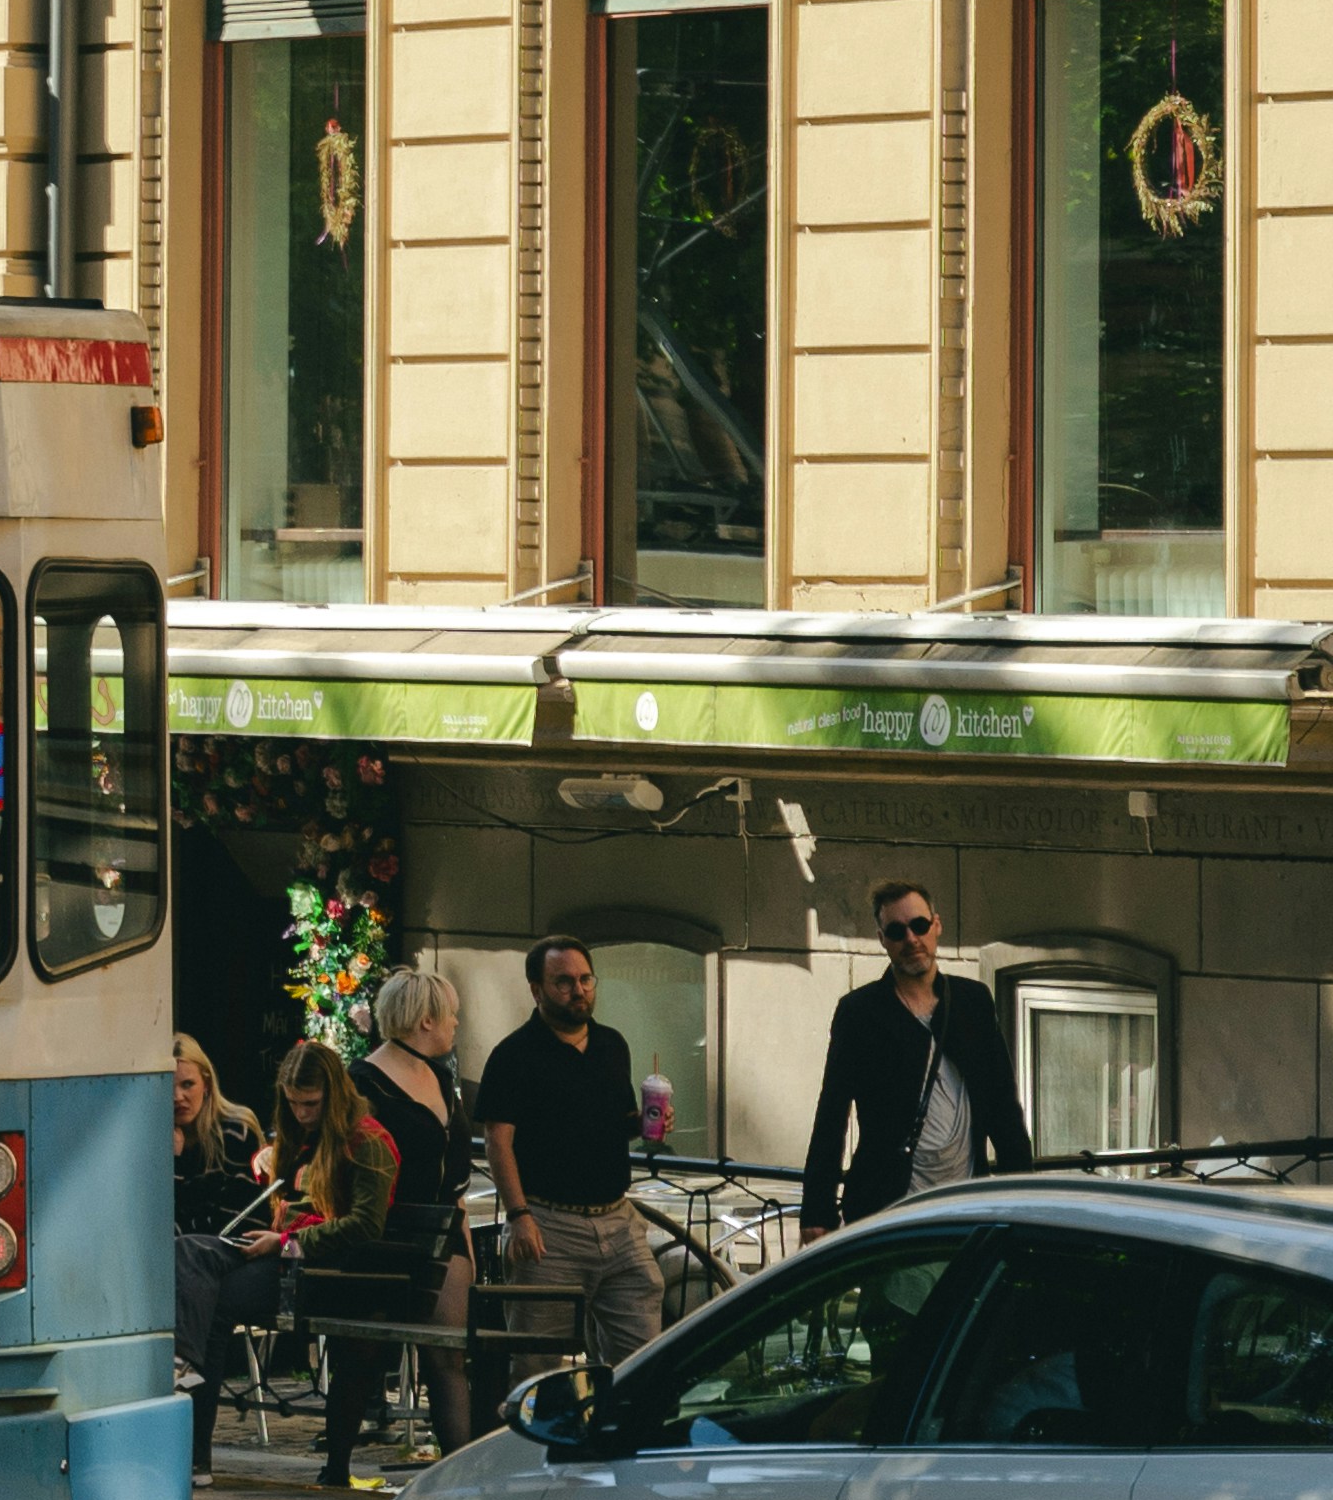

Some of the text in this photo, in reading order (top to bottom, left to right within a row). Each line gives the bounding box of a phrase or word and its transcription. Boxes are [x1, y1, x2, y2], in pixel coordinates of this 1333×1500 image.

[178, 689, 222, 724] happy
[257, 691, 314, 721] kitchen
[842, 703, 862, 722] food
[861, 702, 914, 741] happy
[955, 706, 1023, 739] kitchen
[820, 798, 935, 828] CATERING
